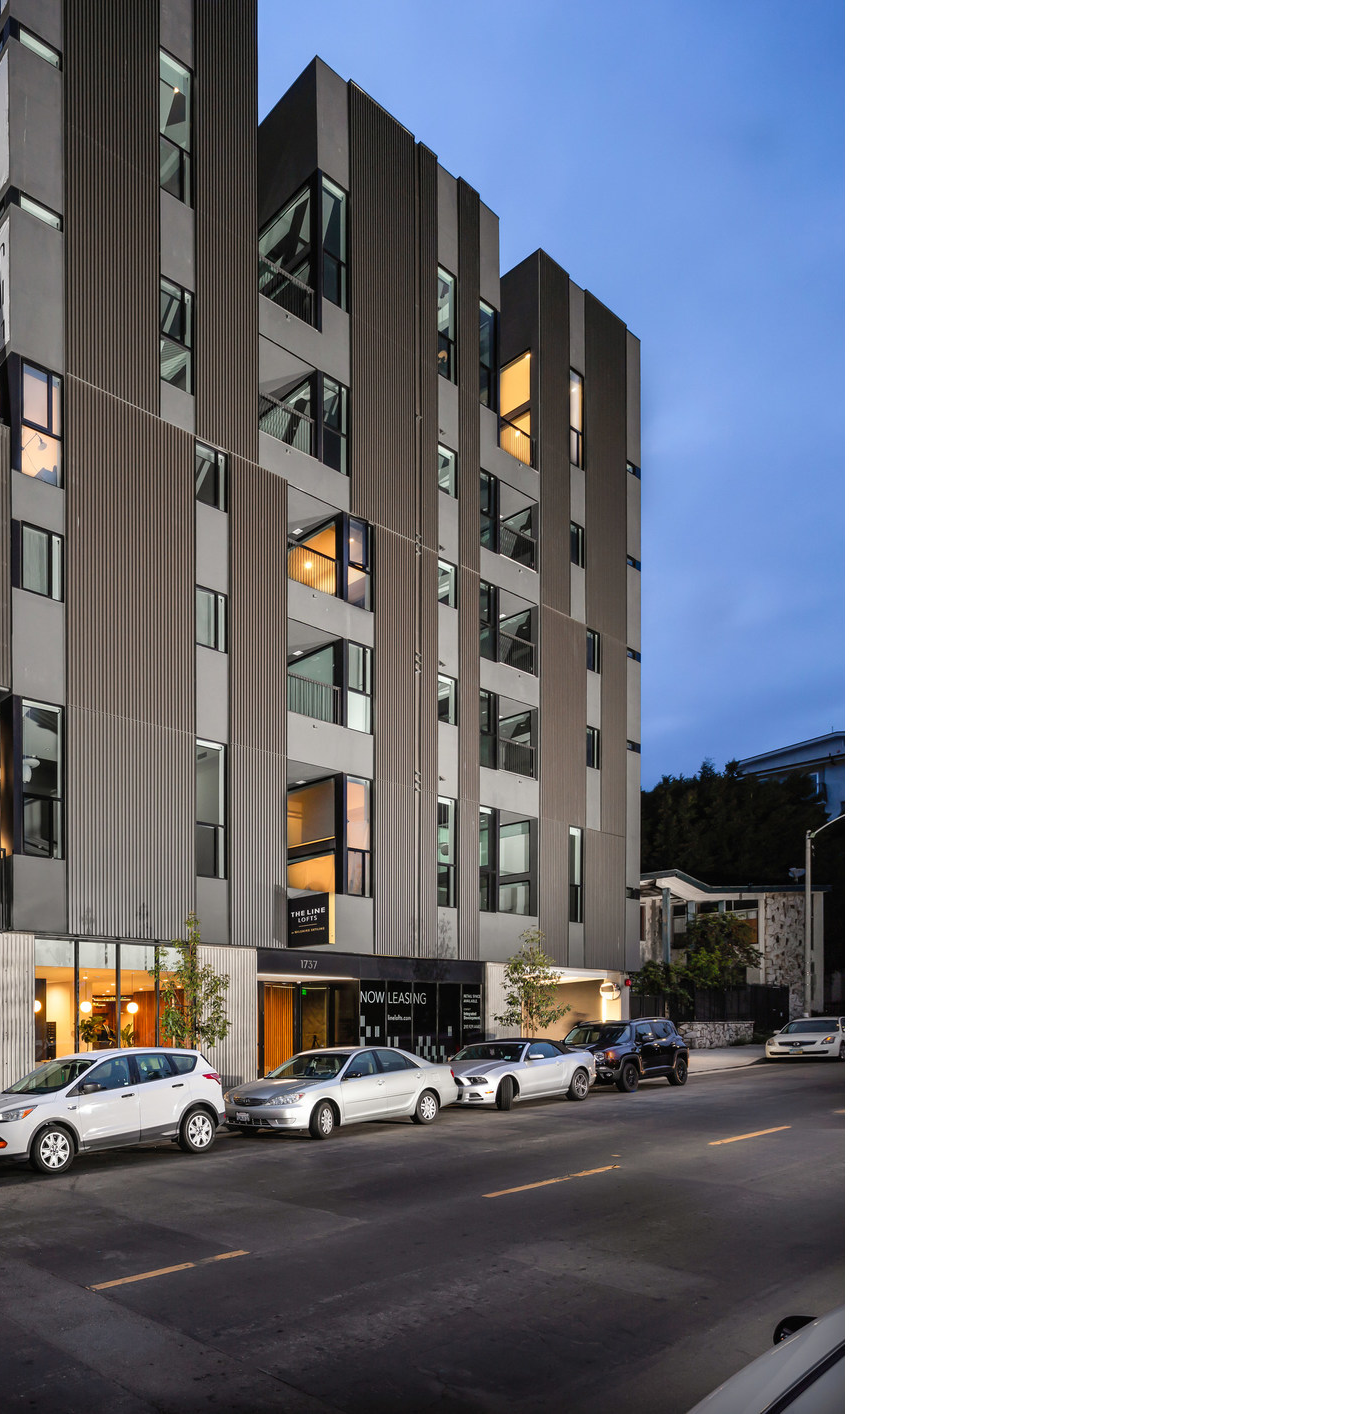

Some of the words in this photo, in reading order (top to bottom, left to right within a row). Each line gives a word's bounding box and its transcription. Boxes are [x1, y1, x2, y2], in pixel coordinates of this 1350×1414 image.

[291, 910, 306, 918] THE
[306, 906, 326, 915] LINE
[297, 915, 318, 923] LOFTS
[300, 959, 318, 970] 1737
[360, 990, 385, 1004] NOW
[387, 991, 427, 1004] LEASING
